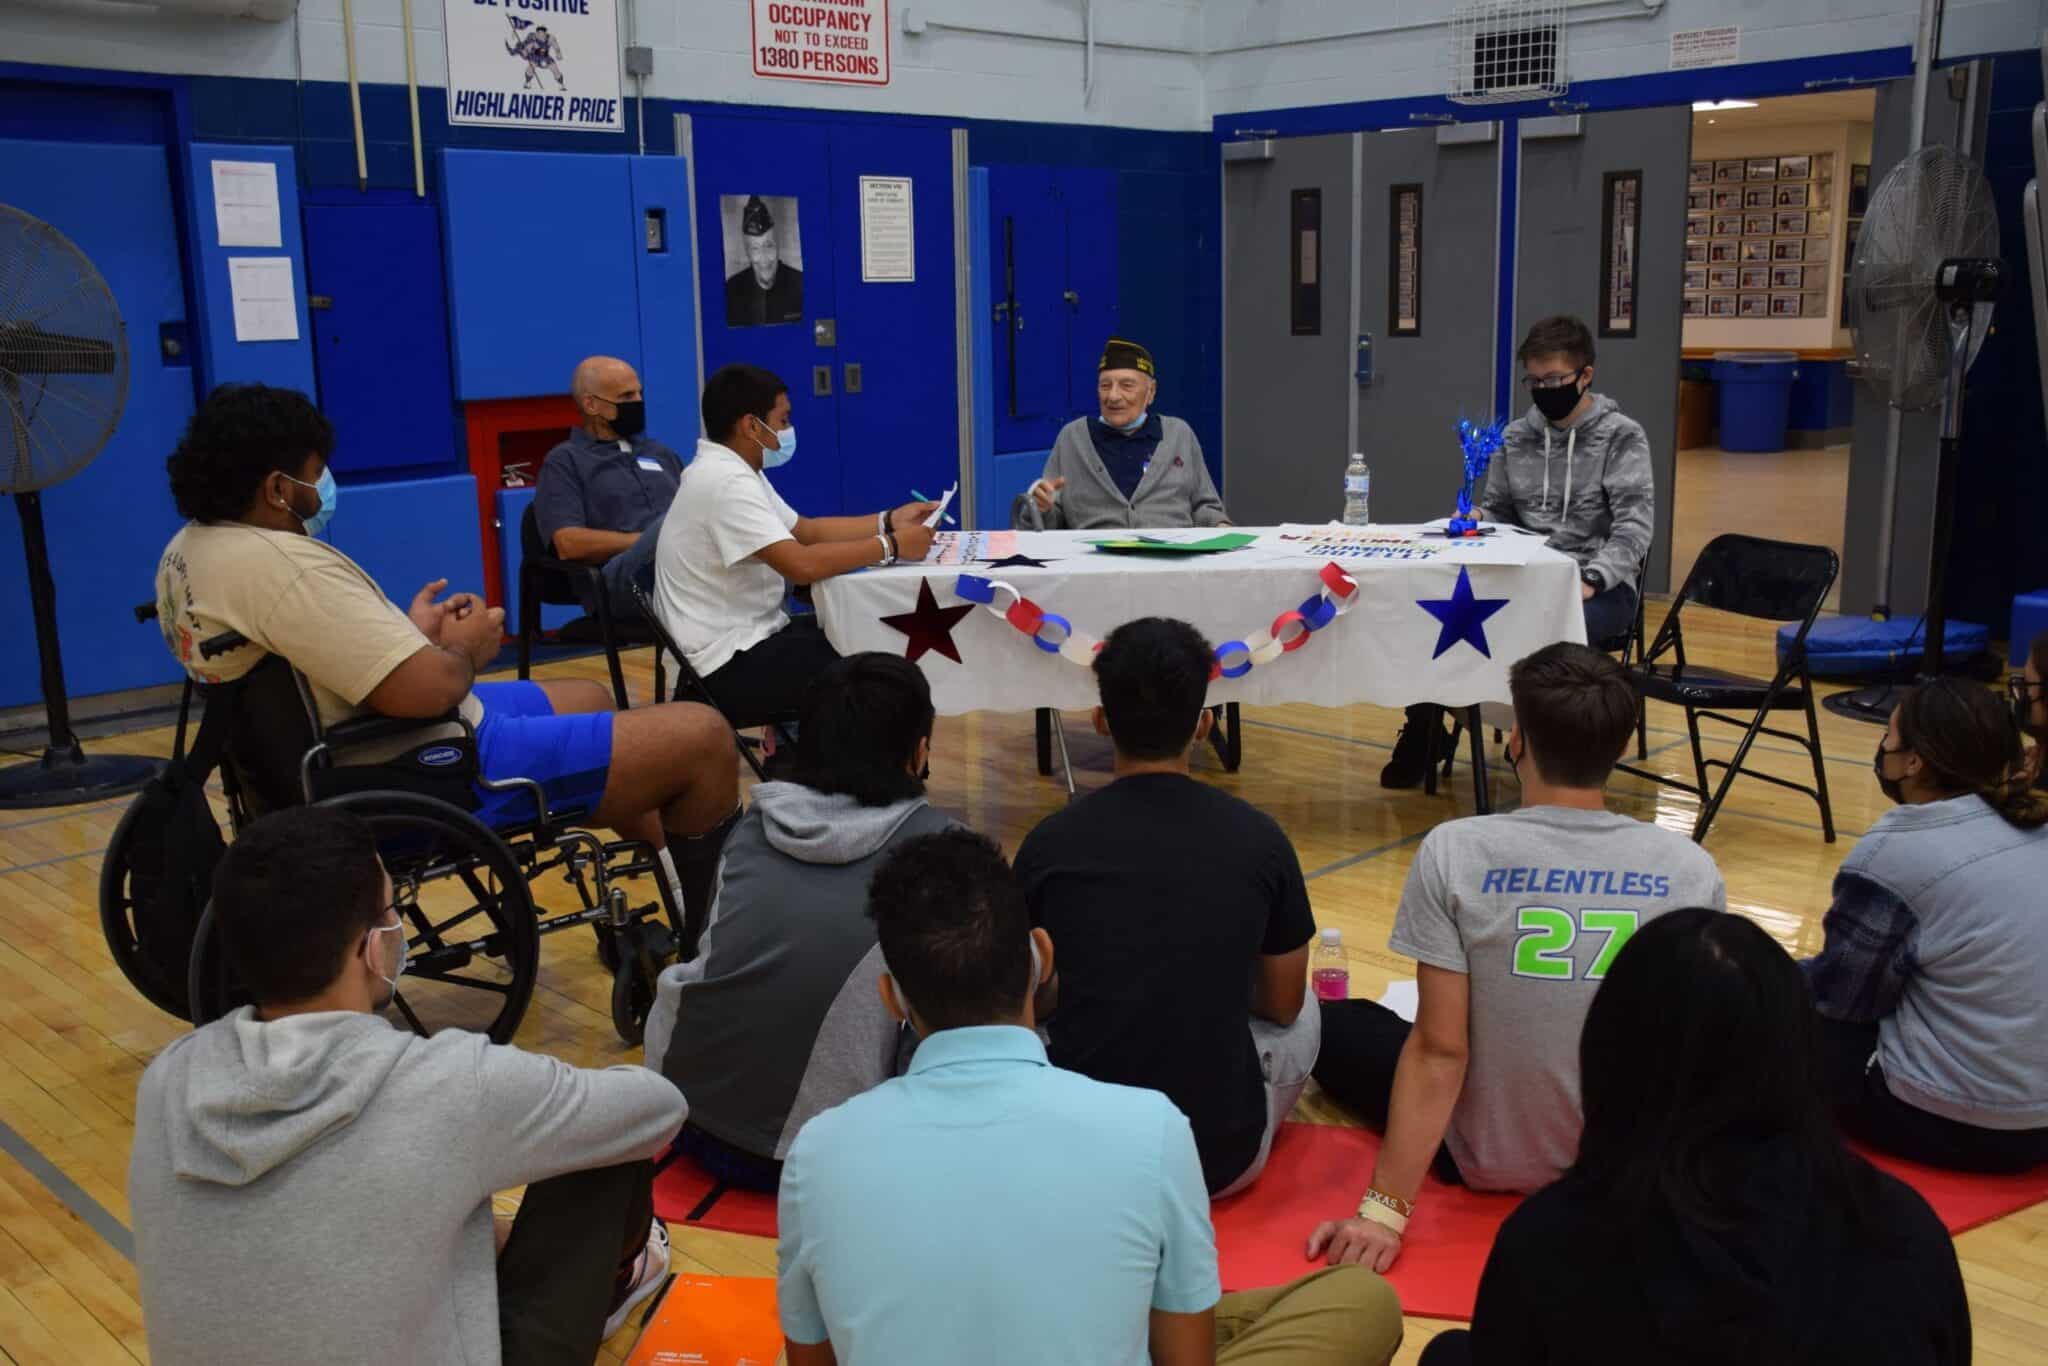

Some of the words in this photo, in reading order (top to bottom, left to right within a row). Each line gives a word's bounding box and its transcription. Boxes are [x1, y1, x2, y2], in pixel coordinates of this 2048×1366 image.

[768, 4, 872, 32] OCCUPANCY
[775, 29, 797, 44] NOT
[804, 32, 820, 46] TO
[825, 34, 868, 50] EXCEED
[760, 46, 799, 69] 1380
[803, 51, 879, 75] PERSONS
[455, 90, 564, 121] HIGHLANDER
[568, 97, 617, 124] PRIDE
[1481, 867, 1670, 897] RELENTLESS
[1511, 905, 1639, 981] 27
